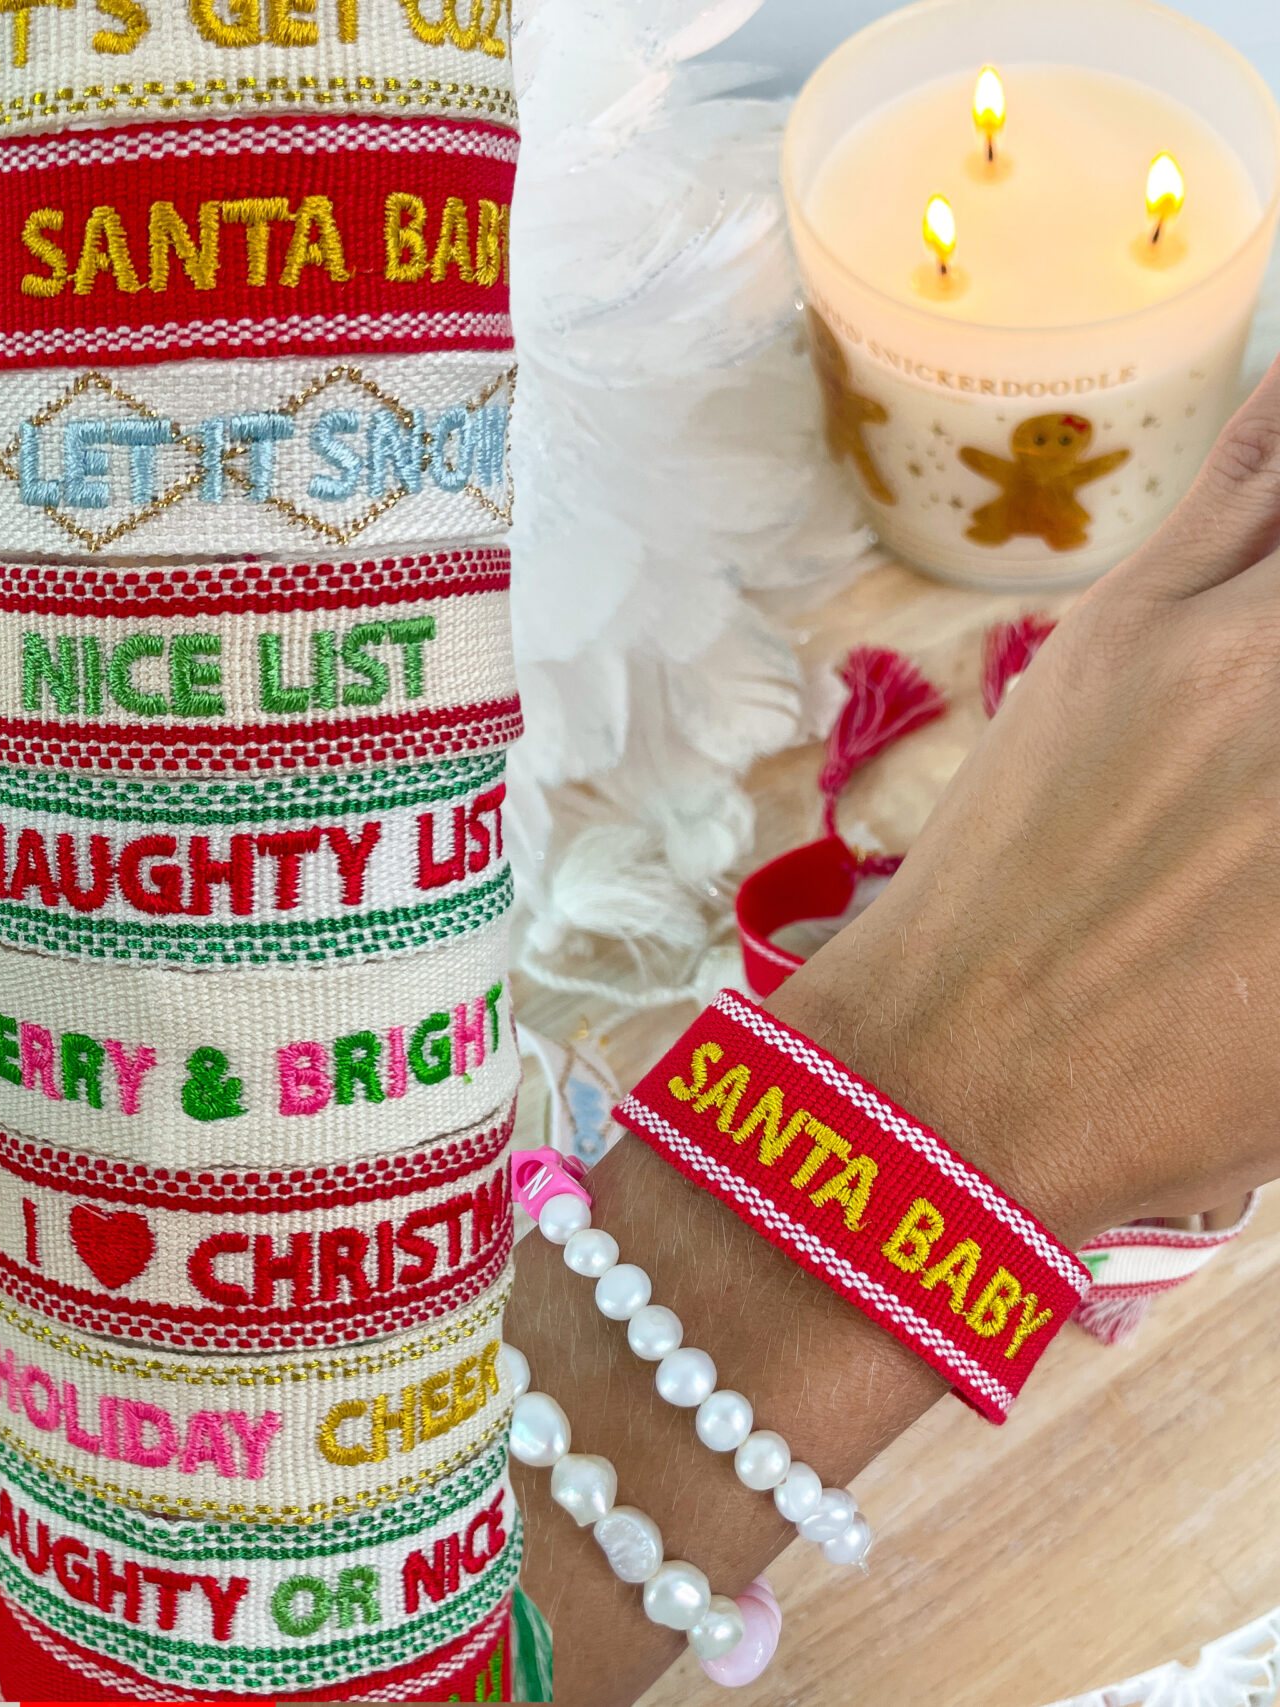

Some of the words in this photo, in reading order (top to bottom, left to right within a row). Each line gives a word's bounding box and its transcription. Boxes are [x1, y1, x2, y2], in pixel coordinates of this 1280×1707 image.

[21, 194, 355, 298] SANTA
[384, 191, 510, 288] BAB
[20, 417, 176, 509] LET
[198, 411, 296, 503] IT
[22, 631, 225, 717] NICE
[257, 615, 436, 714] LIST
[414, 782, 507, 891] LIST
[181, 1046, 247, 1122] &
[277, 981, 503, 1117] BRIGHT
[23, 1197, 41, 1267] I
[668, 1042, 880, 1233] SANTA
[881, 1197, 1053, 1359] BABY
[318, 1339, 500, 1467] CHEER
[271, 1565, 381, 1638] OR
[401, 1487, 506, 1615] NICE
